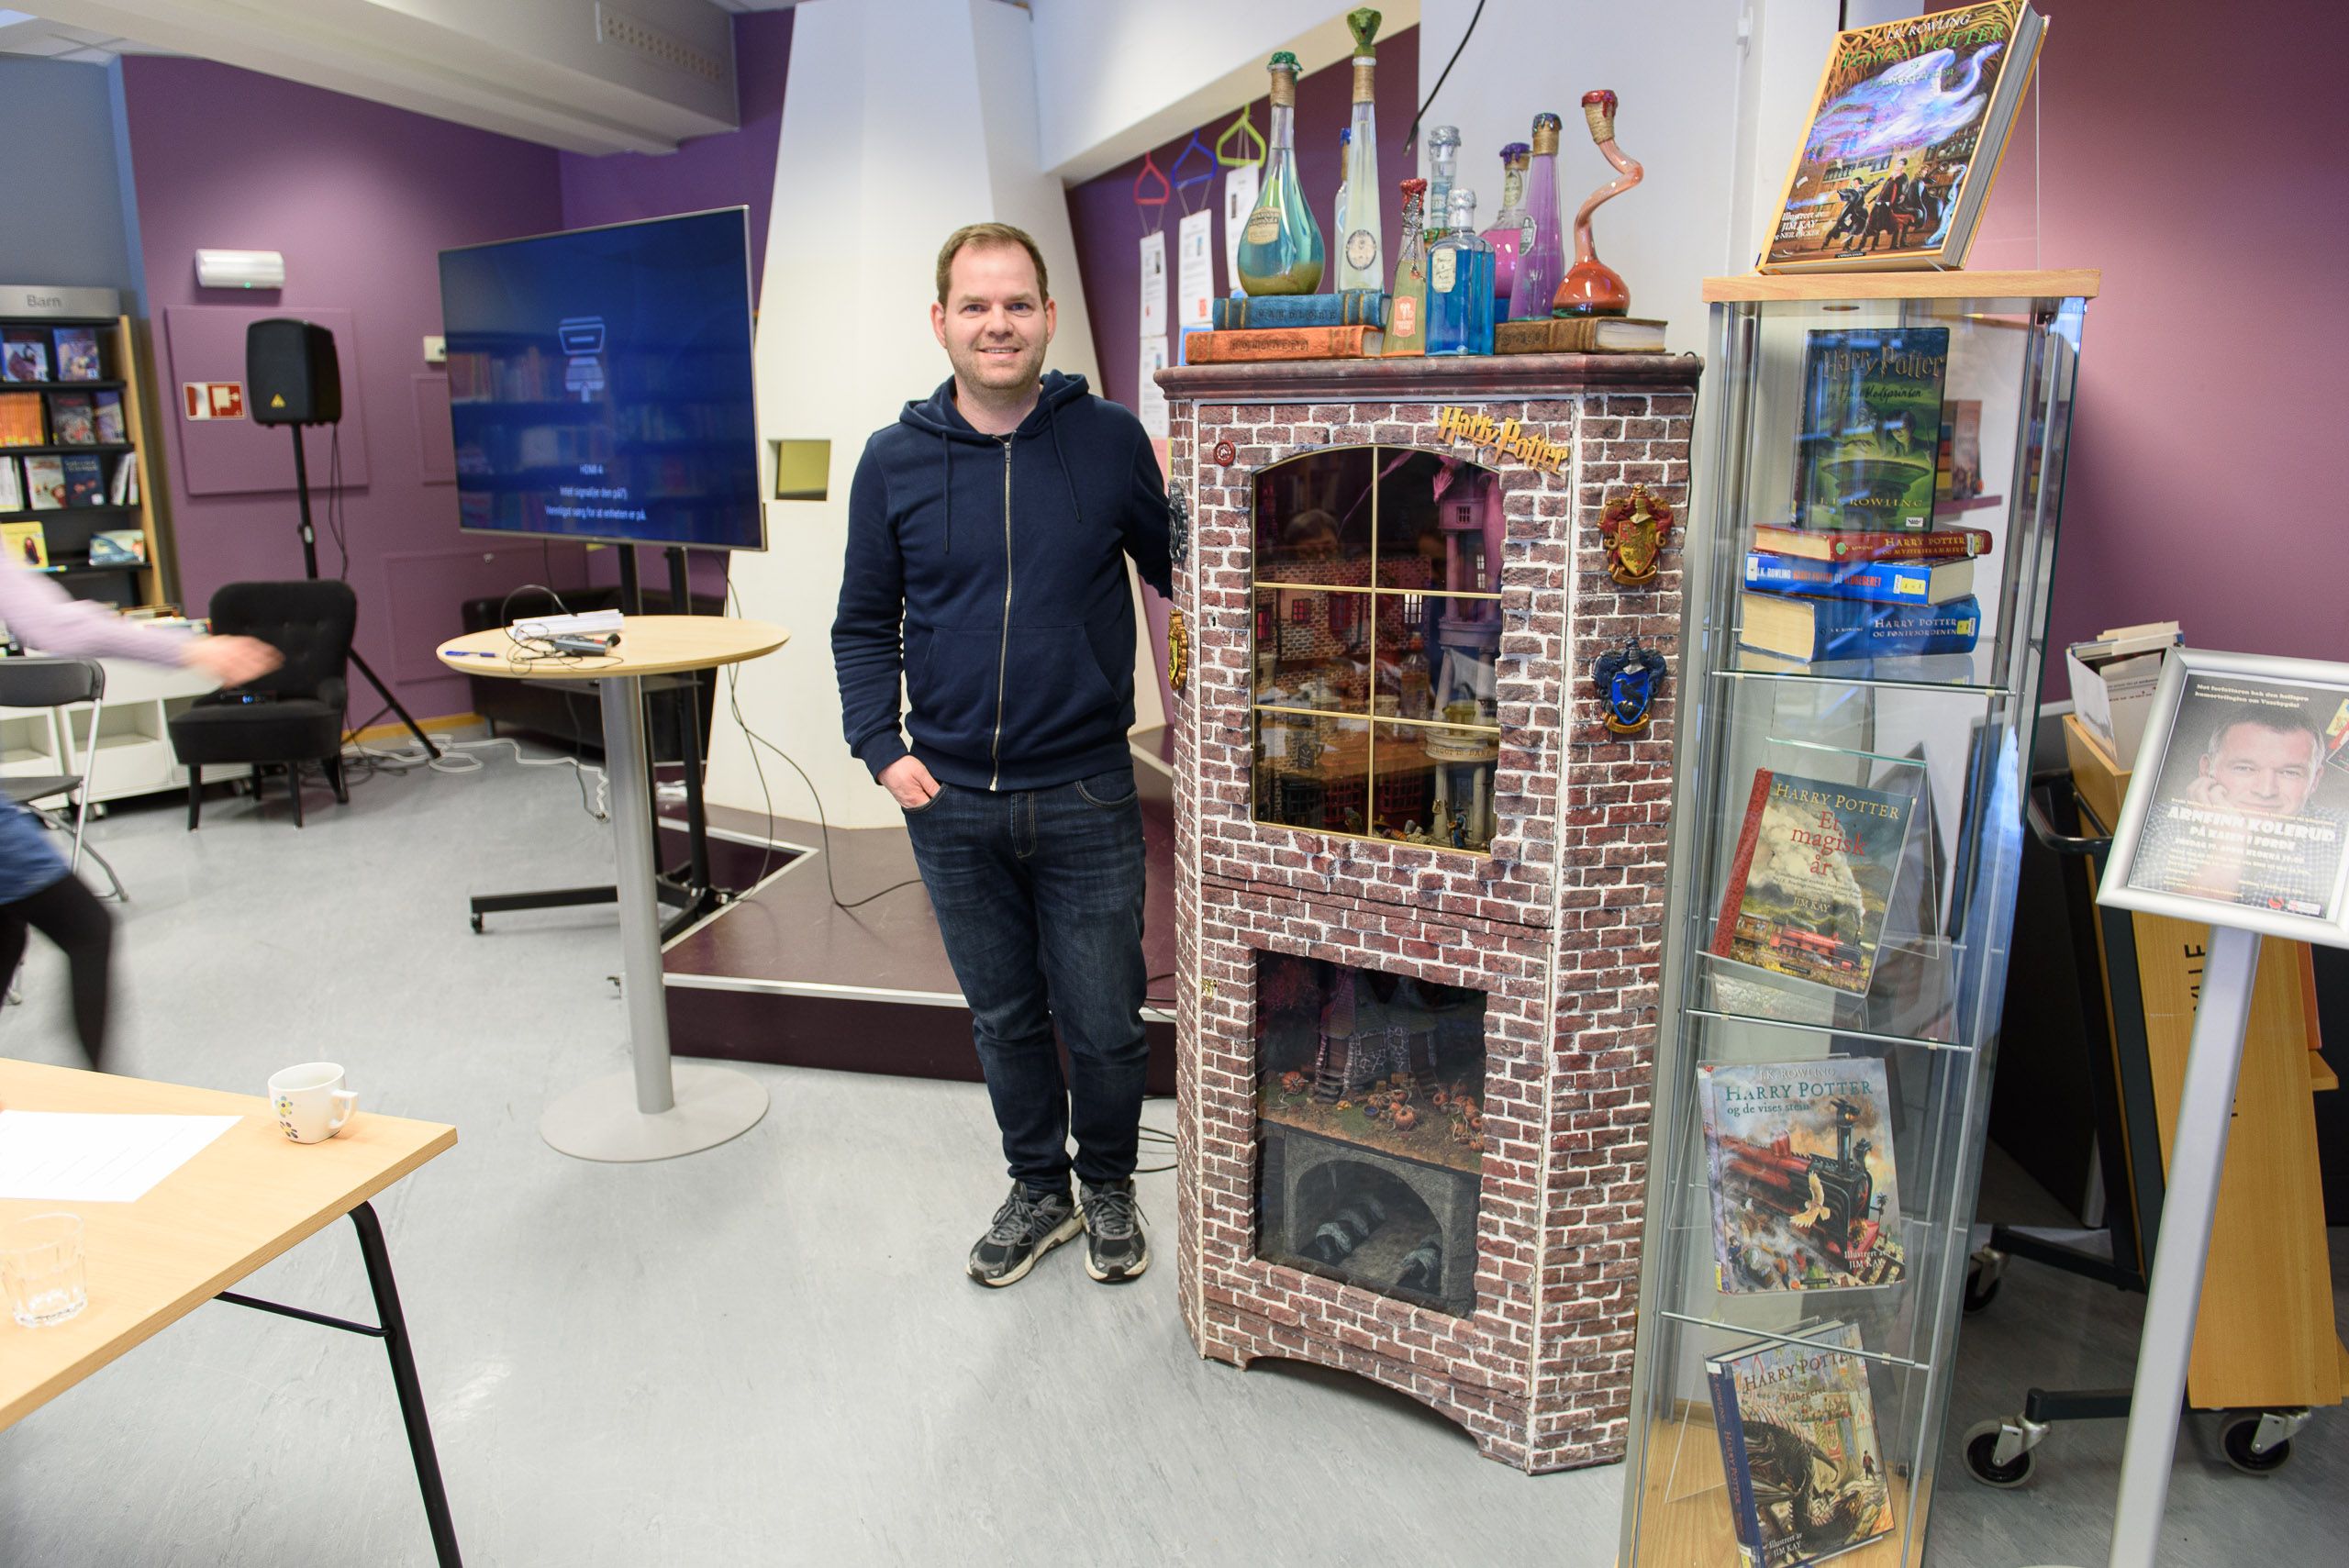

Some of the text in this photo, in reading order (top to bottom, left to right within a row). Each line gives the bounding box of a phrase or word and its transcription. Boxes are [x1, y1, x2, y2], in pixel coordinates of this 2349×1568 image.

[1909, 14, 1971, 36] ROWLING
[1842, 24, 2005, 68] HARRY POTTER
[1781, 218, 1819, 232] JIM KAY
[27, 294, 61, 309] Barn
[1823, 344, 1945, 381] Harry Potter
[1438, 406, 1568, 475] Harry Potter
[1850, 498, 1923, 507] ROWLING
[1885, 536, 1965, 547] HARRY POTTER
[1767, 567, 1791, 580] ROWLING
[1875, 618, 1914, 629] HARRY
[1919, 617, 1957, 628] POTTER
[1776, 783, 1899, 820] HARRY POTTER
[1818, 810, 1842, 832] Et
[2247, 817, 2336, 842] KOLERUD
[1790, 828, 1867, 857] magisk
[1809, 854, 1832, 876] år
[1794, 895, 1830, 913] JIM KAY
[1759, 1067, 1836, 1081] J.K. ROWLING
[1725, 1080, 1874, 1101] HARRY POTTER
[1727, 1106, 1741, 1118] og
[1743, 1103, 1755, 1115] de
[1758, 1102, 1782, 1114] vises
[1844, 1251, 1877, 1260] Illustrert
[1849, 1260, 1864, 1270] JIM
[1744, 1364, 1795, 1392] HARRY
[1769, 1535, 1796, 1550] Illustrert
[1773, 1540, 1801, 1559] JIM KAY
